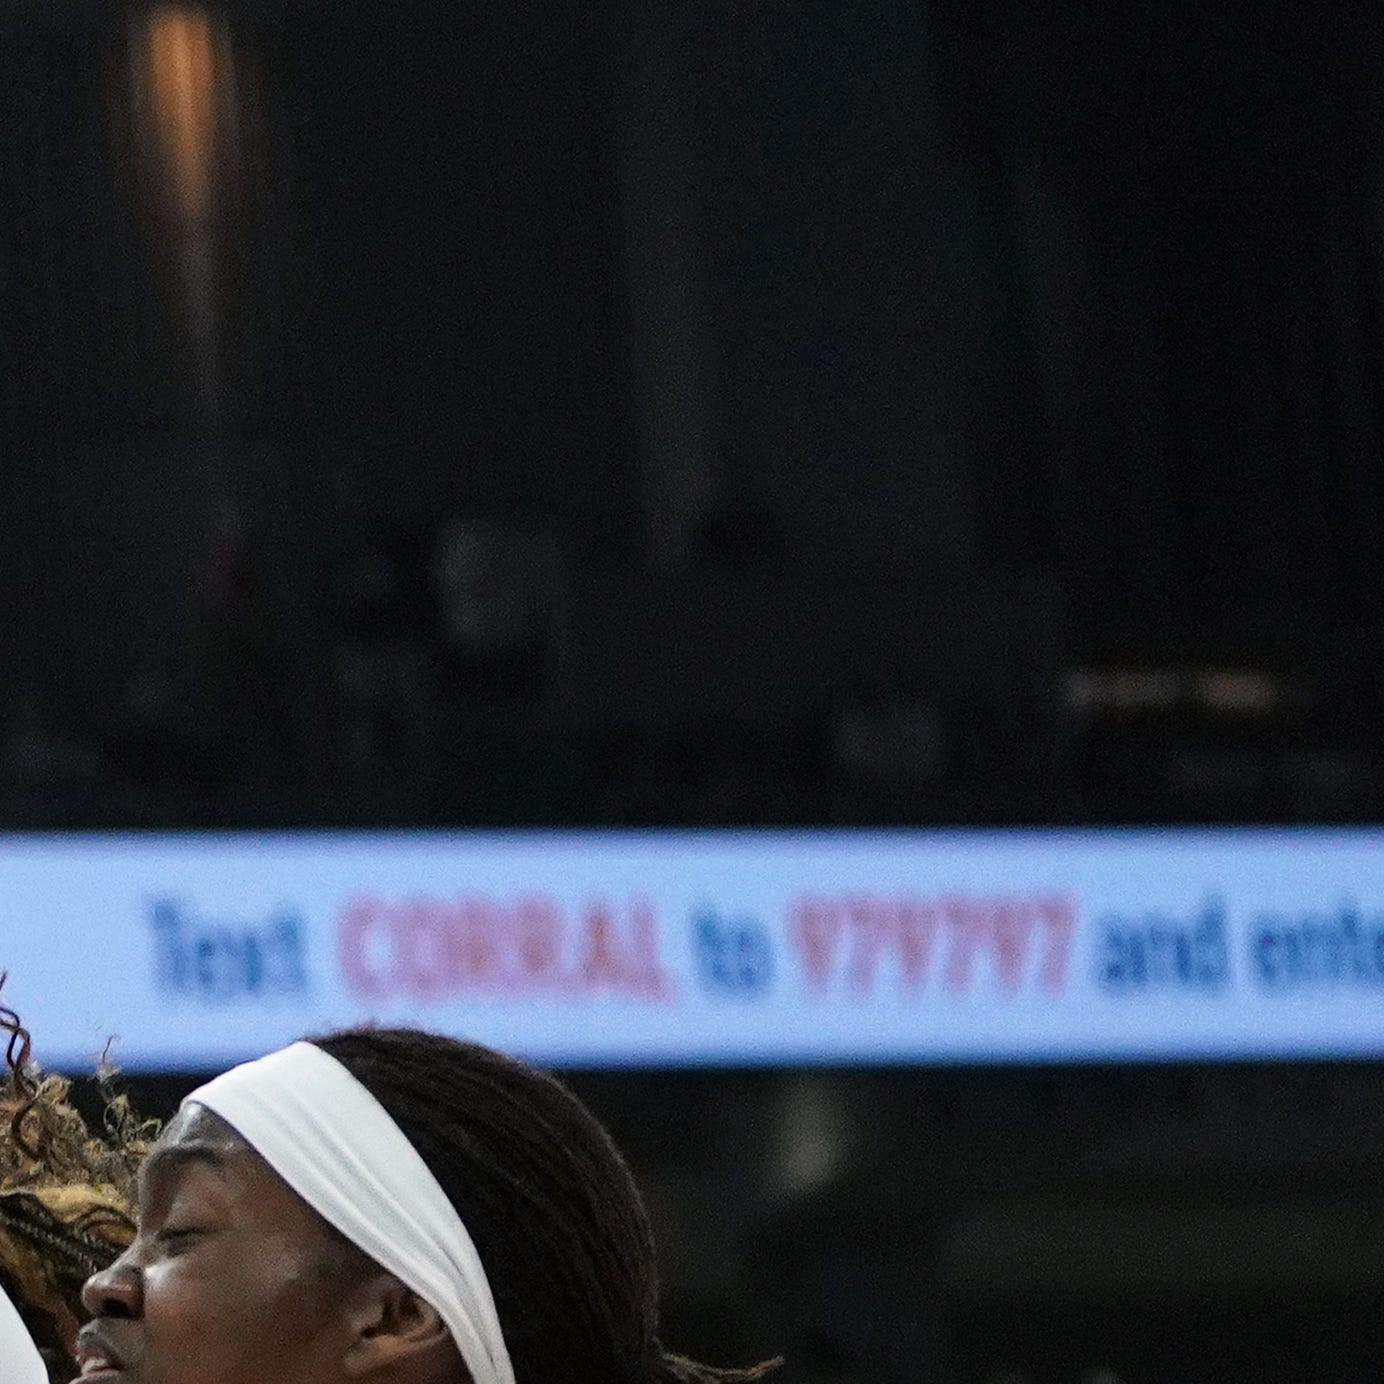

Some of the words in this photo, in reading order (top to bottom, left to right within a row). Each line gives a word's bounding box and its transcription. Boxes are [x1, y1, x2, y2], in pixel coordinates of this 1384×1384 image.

[145, 896, 306, 995] Text
[340, 892, 674, 1002] CORRAL
[689, 904, 772, 998] to
[786, 892, 1078, 1000] 979797
[1095, 896, 1227, 998] and
